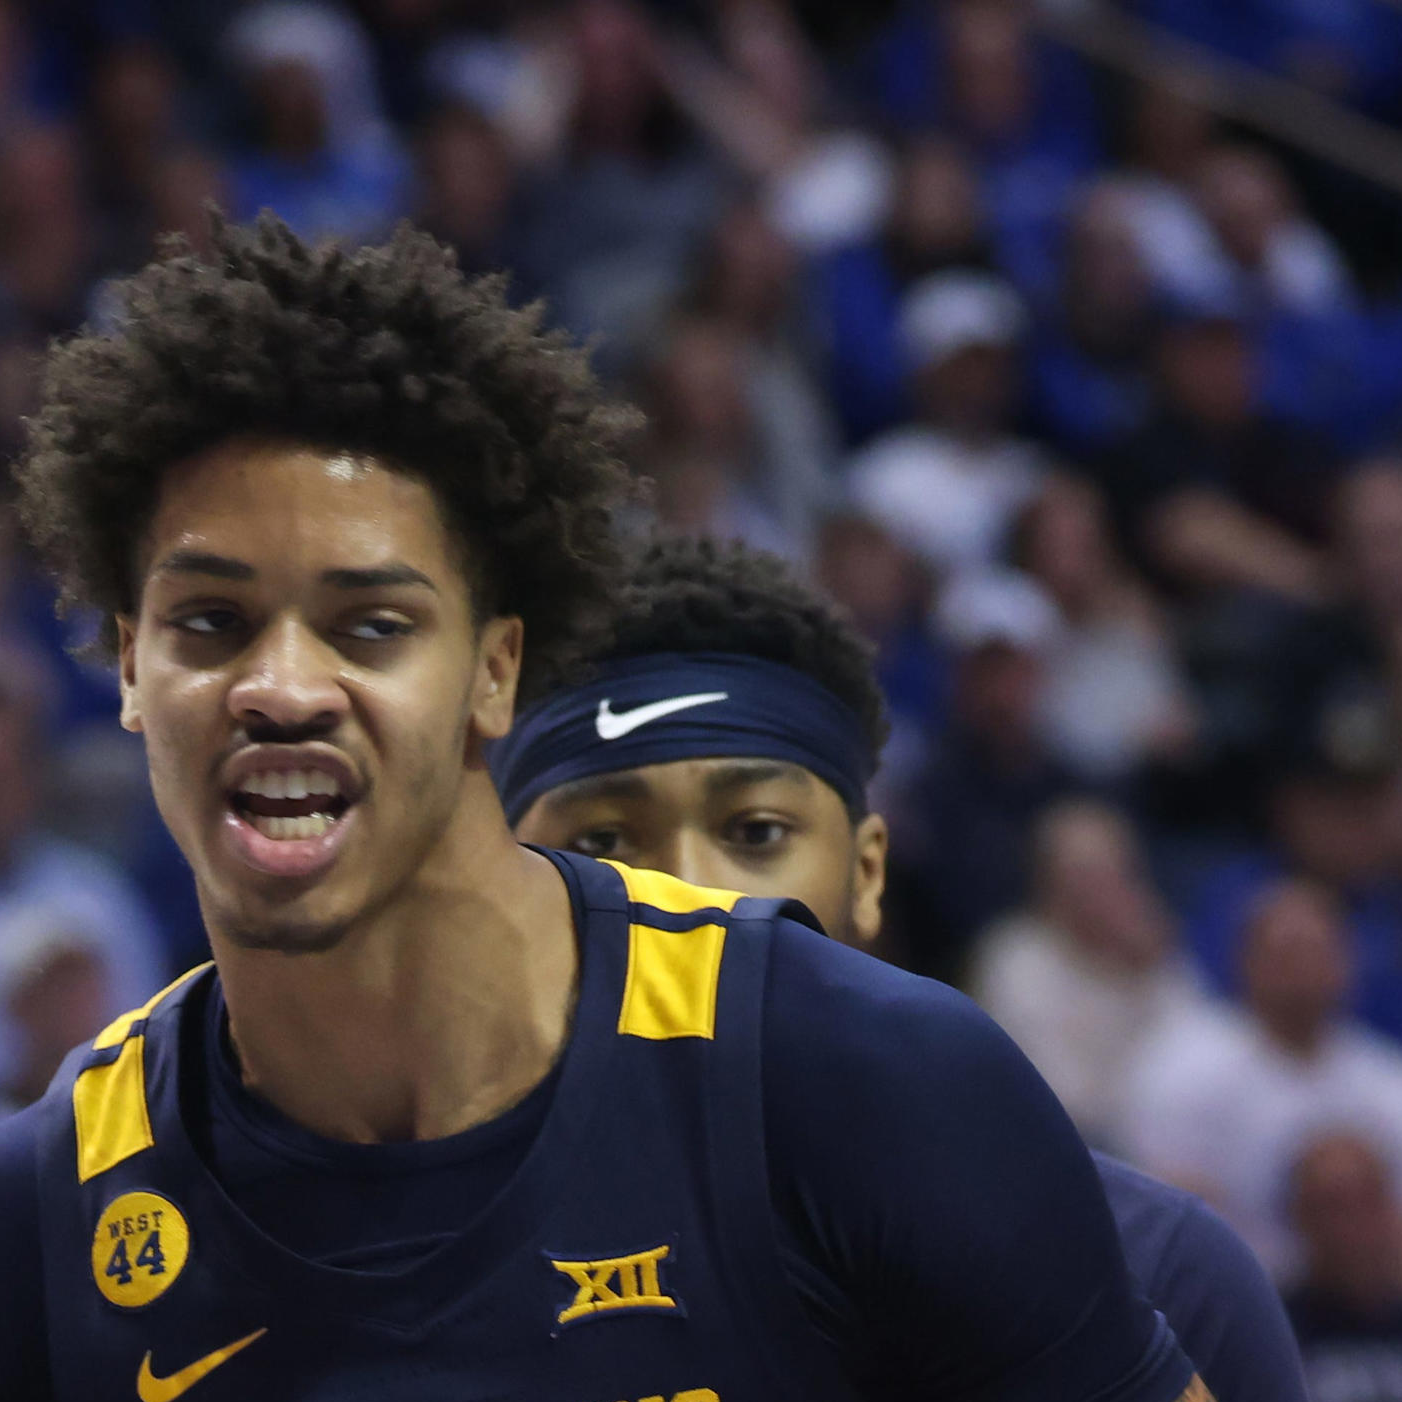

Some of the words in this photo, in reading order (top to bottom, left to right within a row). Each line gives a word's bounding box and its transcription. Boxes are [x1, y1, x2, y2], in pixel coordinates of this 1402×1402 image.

[108, 1210, 164, 1239] WEST
[105, 1230, 166, 1285] 44
[551, 1245, 677, 1324] XII
